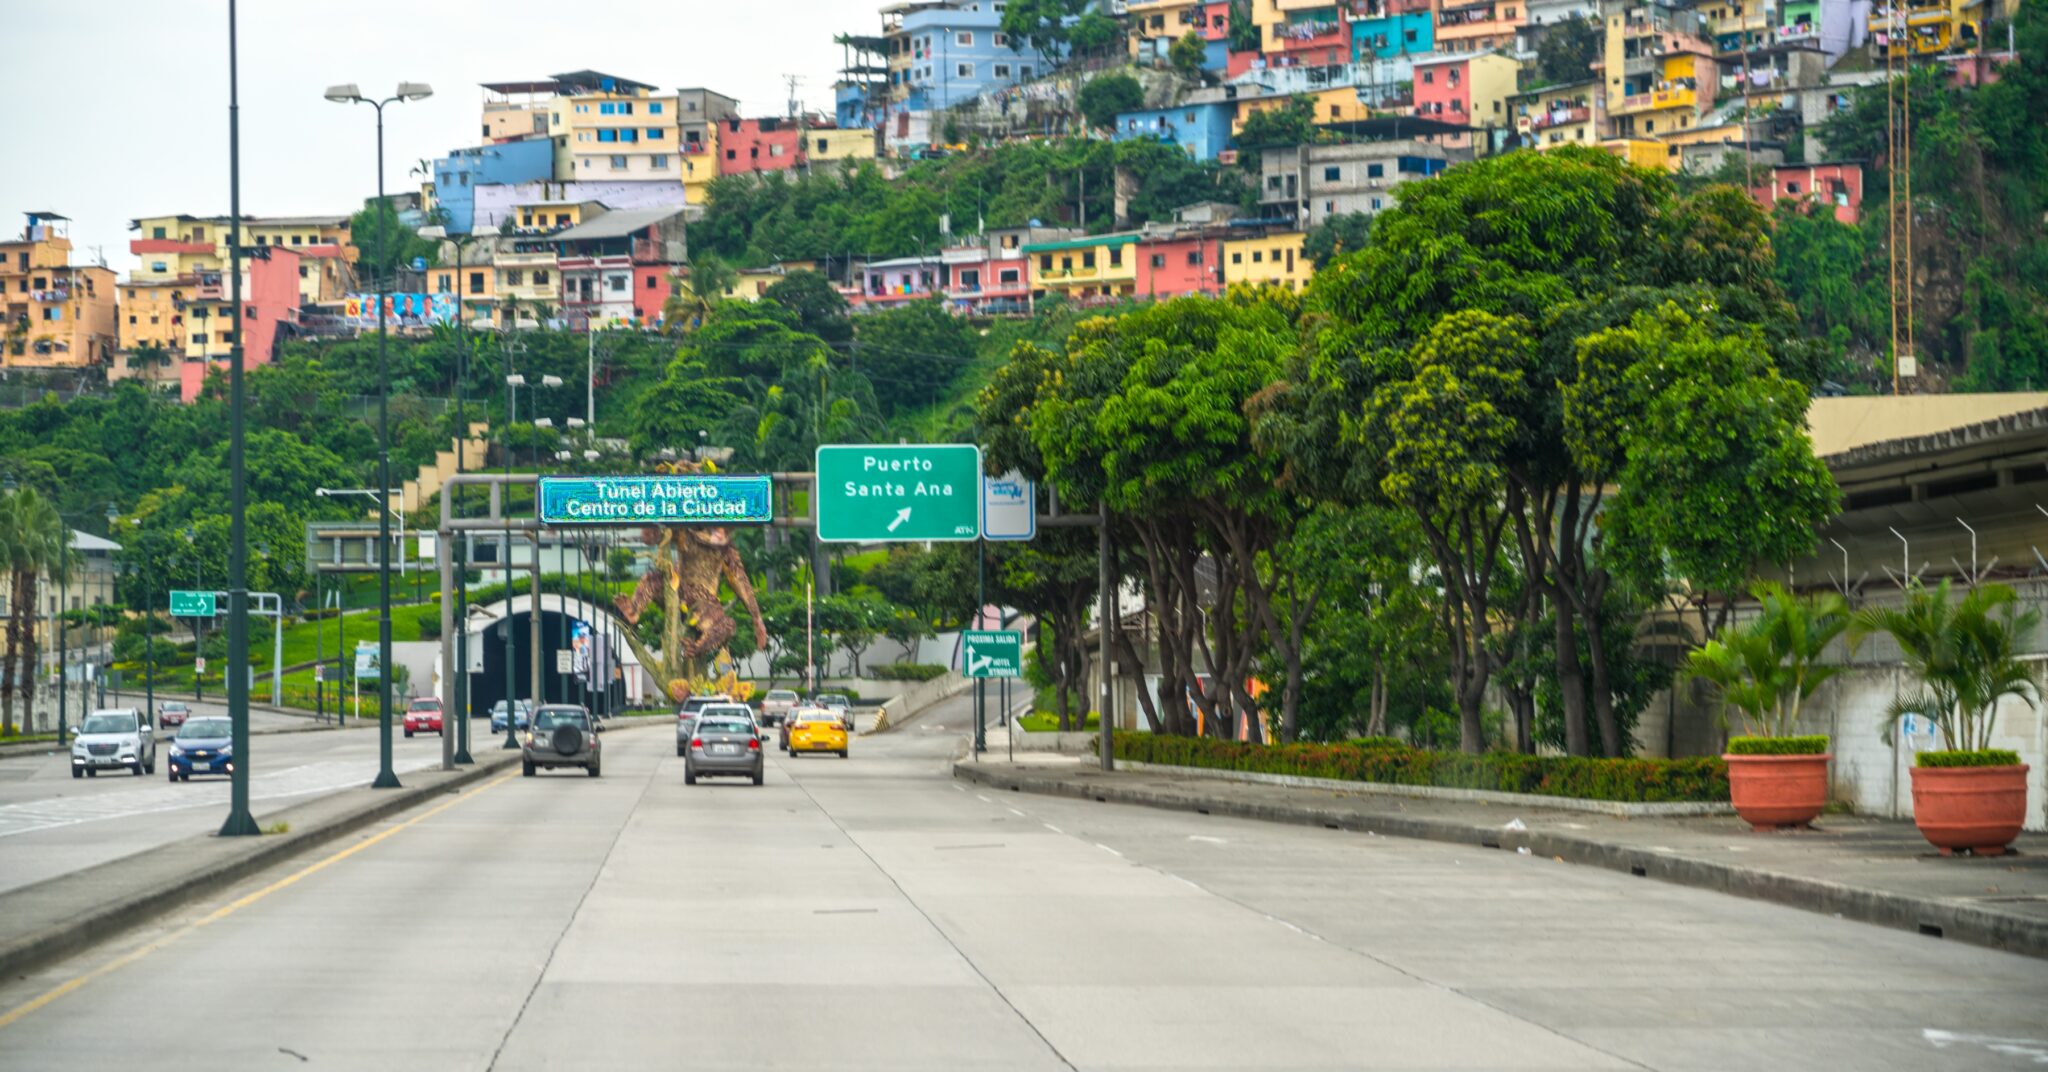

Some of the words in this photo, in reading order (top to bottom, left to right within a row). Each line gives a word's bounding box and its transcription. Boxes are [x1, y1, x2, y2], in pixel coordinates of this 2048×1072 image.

[863, 456, 932, 472] Puerto
[652, 482, 718, 499] Abierto
[844, 481, 905, 497] Santa
[914, 481, 953, 497] Ana
[567, 500, 628, 516] Centro
[633, 500, 656, 516] de
[661, 500, 677, 515] la
[683, 499, 747, 516] Ciudad
[995, 634, 1016, 644] SALIDA
